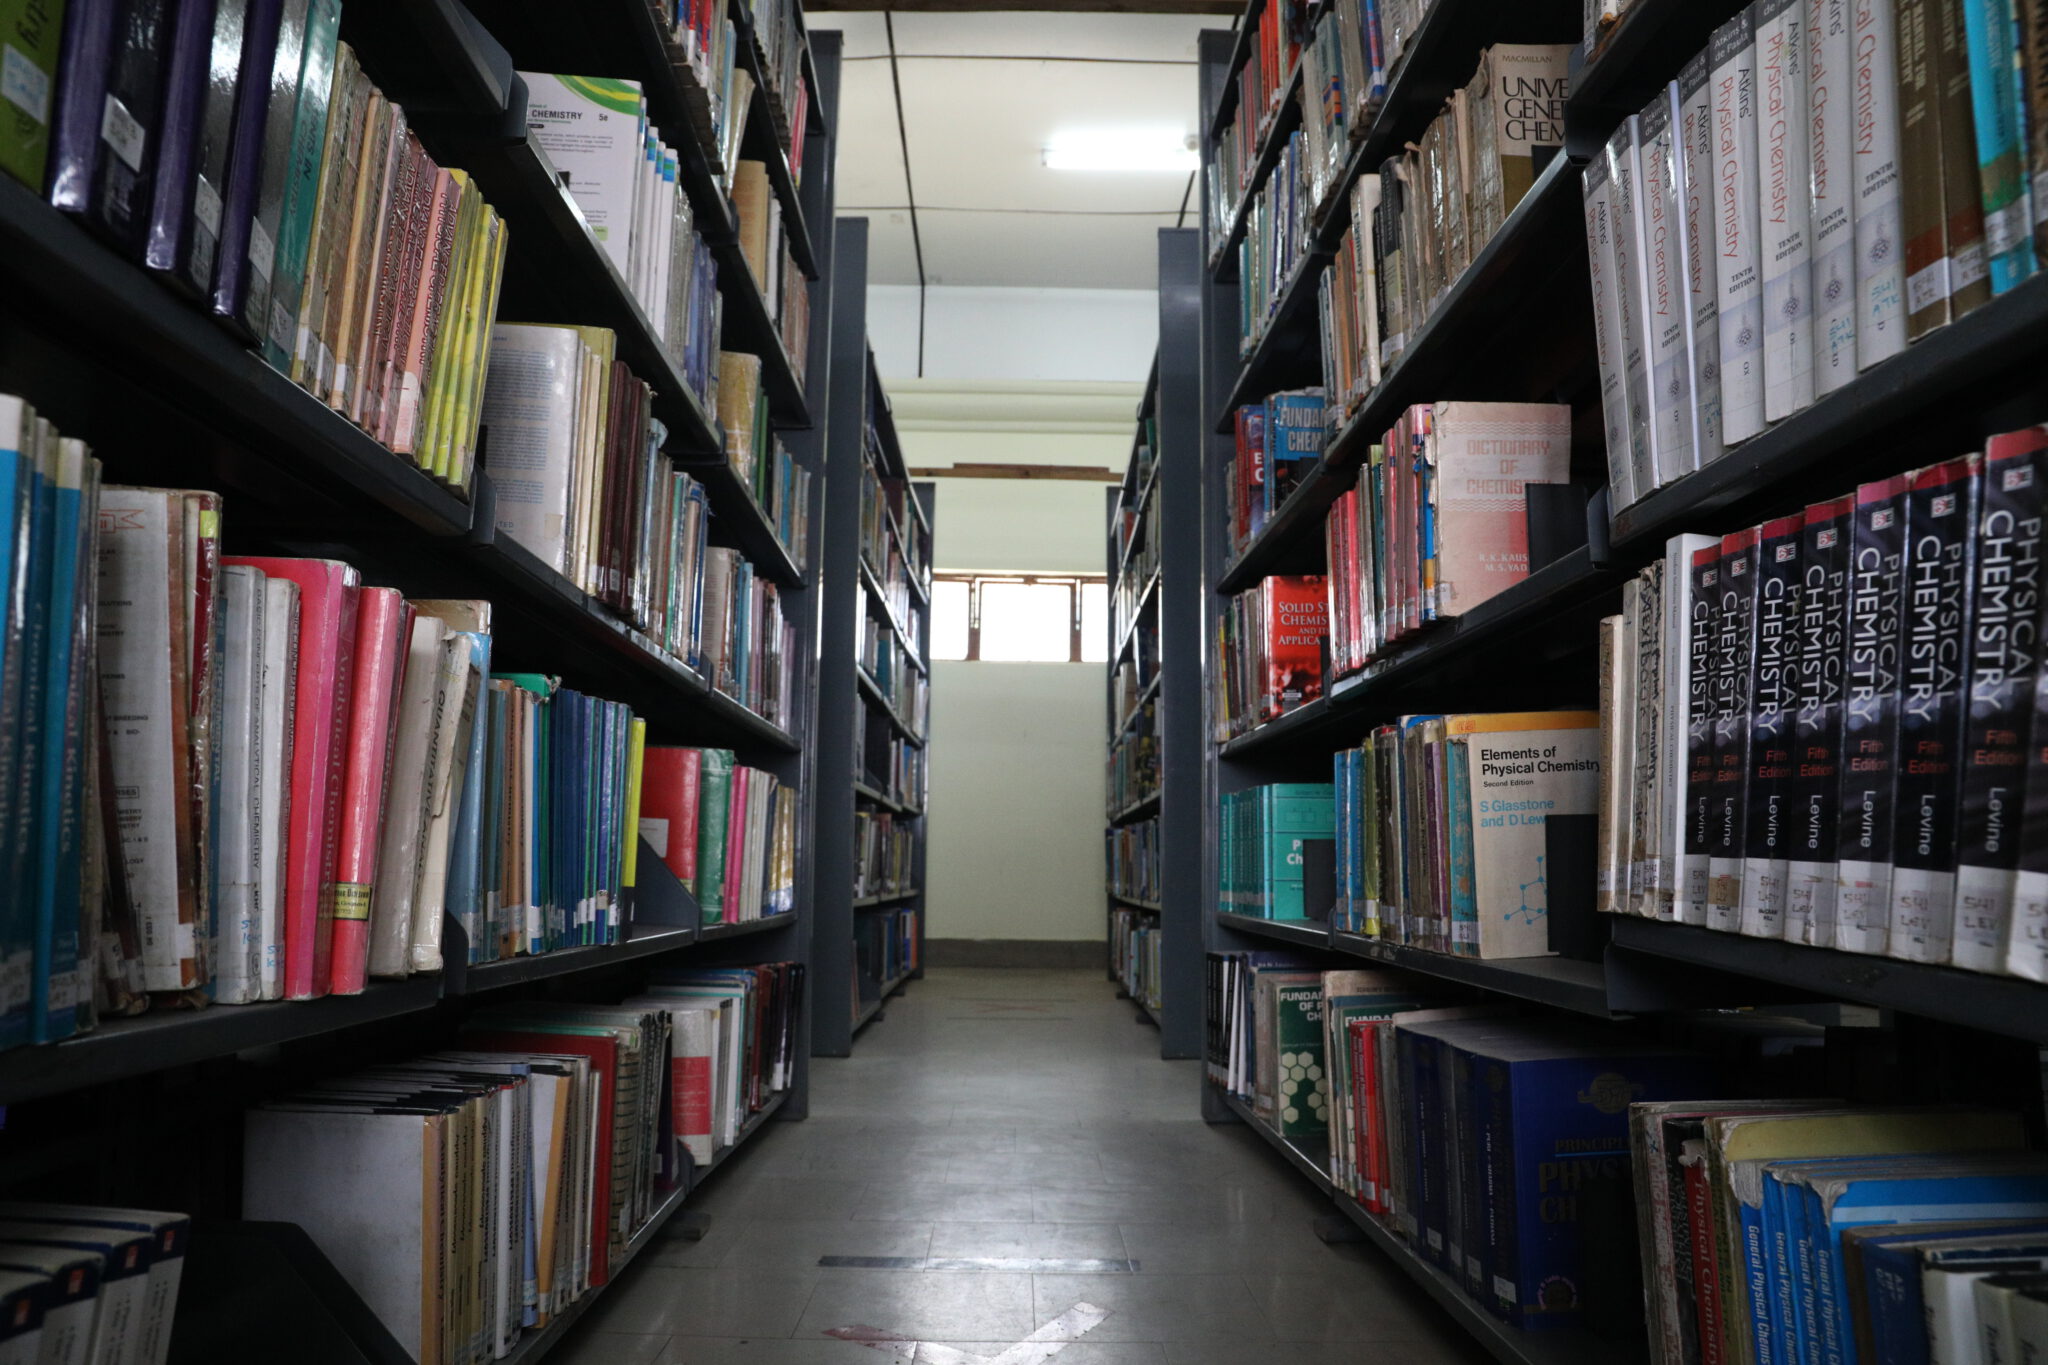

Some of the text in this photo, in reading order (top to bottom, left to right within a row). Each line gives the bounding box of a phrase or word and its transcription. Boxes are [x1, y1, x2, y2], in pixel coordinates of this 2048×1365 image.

[1714, 27, 1740, 49] Atkins
[1763, 3, 1775, 15] de
[1502, 54, 1552, 63] MACMILLAN
[1715, 32, 1749, 61] de Paula
[531, 109, 583, 120] CHEMISTRY
[599, 113, 608, 122] 5e
[1856, 34, 1877, 155] Chemistry
[1764, 32, 1788, 222] Physical Chemistry
[1812, 86, 1829, 199] Chemistry
[1716, 76, 1740, 257] Physical Chemistry
[1862, 172, 1897, 198] EDITION
[1866, 161, 1893, 183] TENTH
[1684, 113, 1702, 294] Physical Chemistry
[1817, 217, 1848, 241] EDITION
[1819, 207, 1844, 227] TENTH
[1775, 240, 1803, 261] EDITION
[1778, 231, 1800, 249] TENTH
[1729, 274, 1756, 294] EDITION
[1731, 266, 1753, 282] TENTH
[1467, 440, 1551, 455] DICTIONARY
[1501, 459, 1519, 474] OF
[1278, 602, 1314, 613] SOLID
[1850, 547, 1880, 721] CHEMISTRY
[1877, 553, 1899, 706] PHYSICAL
[1908, 535, 1941, 722] CHEMISTRY
[1937, 542, 1962, 708] PHYSICAL
[1972, 510, 2014, 709] CHEMISTRY
[2006, 517, 2041, 695] PHYSICAL
[1690, 601, 1708, 741] CHEMISTRY
[1717, 591, 1737, 740] CHEMISTRY
[1735, 597, 1750, 723] PHYSICAL
[1758, 577, 1784, 734] CHEMISTRY
[1781, 584, 1801, 722] PHYSICAL
[1799, 565, 1824, 730] CHEMISTRY
[1822, 571, 1843, 719] PHYSICAL
[252, 715, 261, 791] ANALYTICAL
[321, 646, 349, 898] Analytical Chemistry
[424, 689, 446, 818] QUANTITATIVE
[1481, 745, 1557, 761] Elements of
[1482, 759, 1600, 777] Physical Chemistry
[19, 743, 37, 854] Kinetics
[61, 746, 77, 854] Kinetics
[1480, 800, 1555, 813] S Glasstone
[1483, 780, 1508, 788] Second
[251, 796, 260, 869] CHEMISTRY
[1480, 816, 1504, 828] and
[1508, 814, 1519, 826] D
[1697, 797, 1707, 843] Levine
[1723, 798, 1734, 846] Levine
[1767, 796, 1781, 847] Levine
[1808, 795, 1822, 849] Levine
[1860, 790, 1876, 848] Levine
[1918, 795, 1935, 855] Levine
[1985, 787, 2006, 852] Levine
[1299, 1002, 1314, 1011] OF
[1695, 1183, 1718, 1365] Physical Chemistry
[1748, 1225, 1761, 1269] General
[1751, 1271, 1766, 1321] Physical
[1776, 1231, 1794, 1329] General Physical
[1798, 1240, 1818, 1340] General Physical
[1818, 1250, 1838, 1351] General Physical
